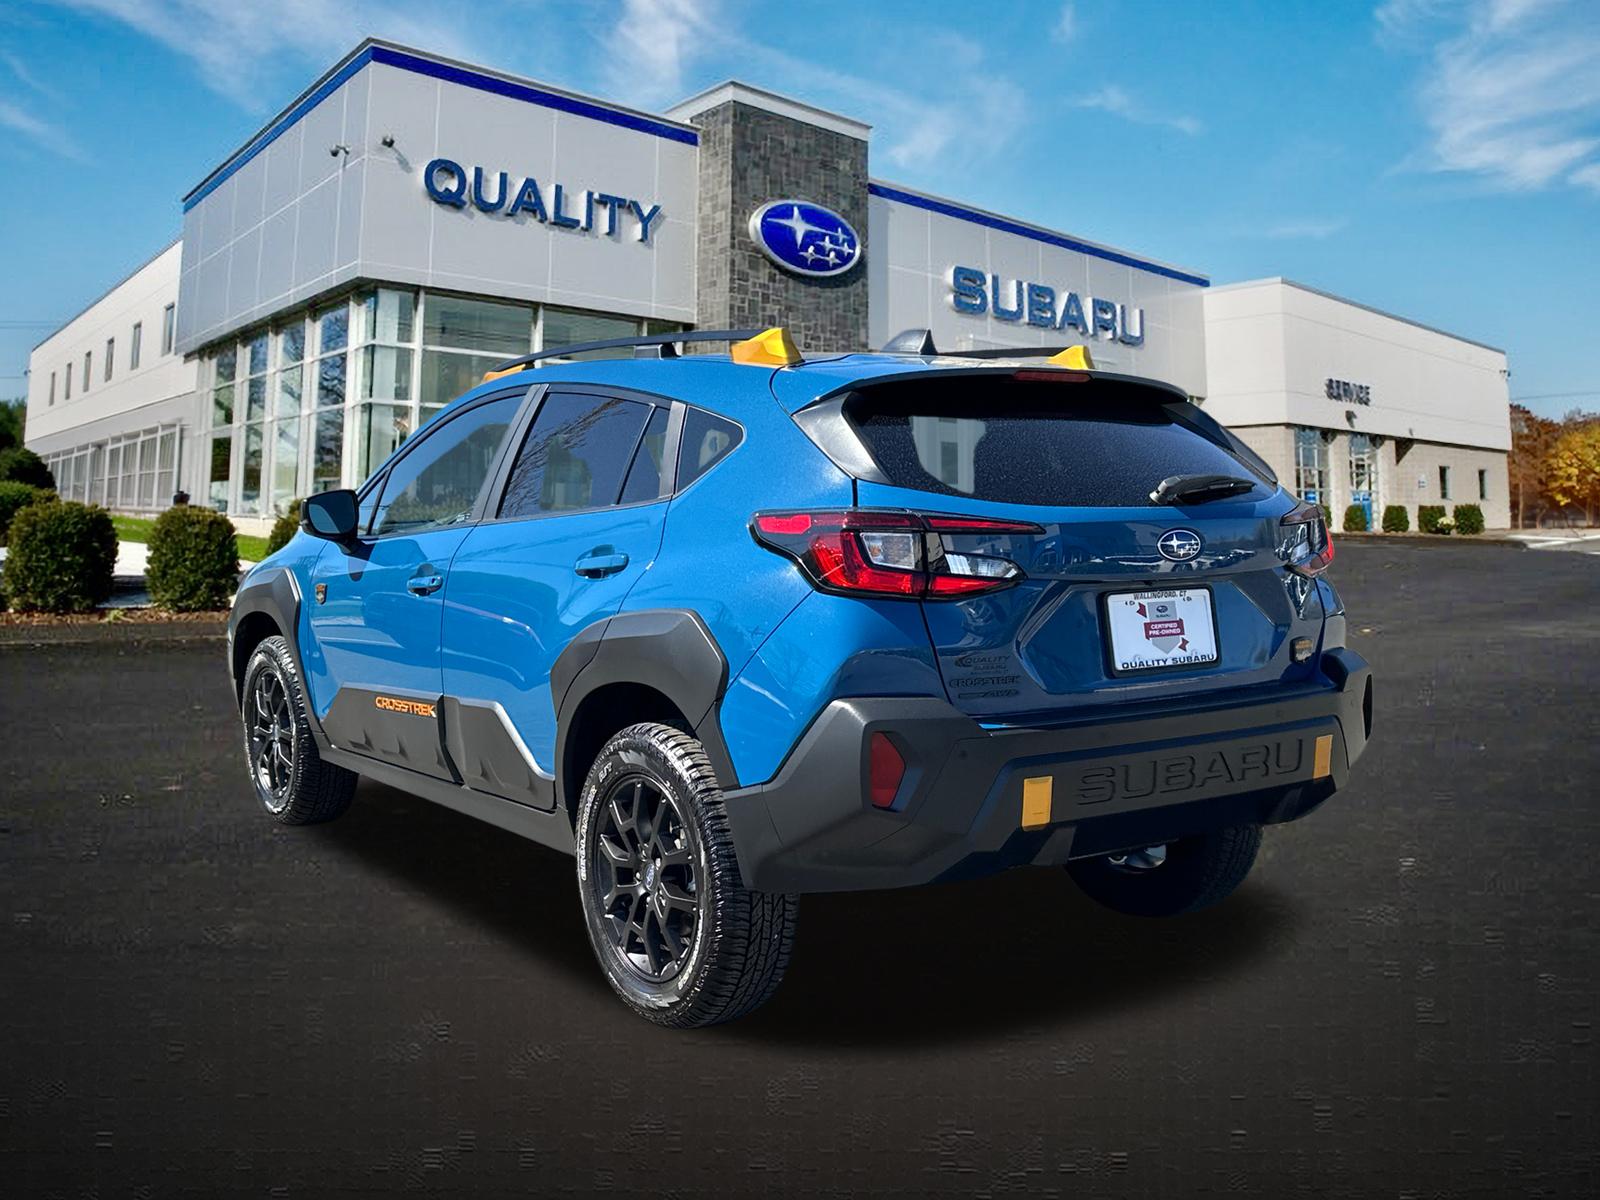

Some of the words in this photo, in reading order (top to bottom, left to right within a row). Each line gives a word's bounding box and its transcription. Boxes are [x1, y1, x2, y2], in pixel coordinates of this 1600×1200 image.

[423, 158, 662, 243] QUALITY
[950, 265, 1145, 347] SUBARU
[1326, 378, 1370, 406] SERVICE
[1179, 590, 1187, 598] CT
[1149, 628, 1181, 636] PRE-OWNED
[1150, 622, 1178, 630] CERTIFIED
[1121, 659, 1168, 669] QUALITY
[1172, 654, 1215, 665] SUBARU
[949, 676, 1020, 688] CROSSTREK
[375, 696, 437, 717] CROSSTREK
[1077, 738, 1304, 805] SUBARU
